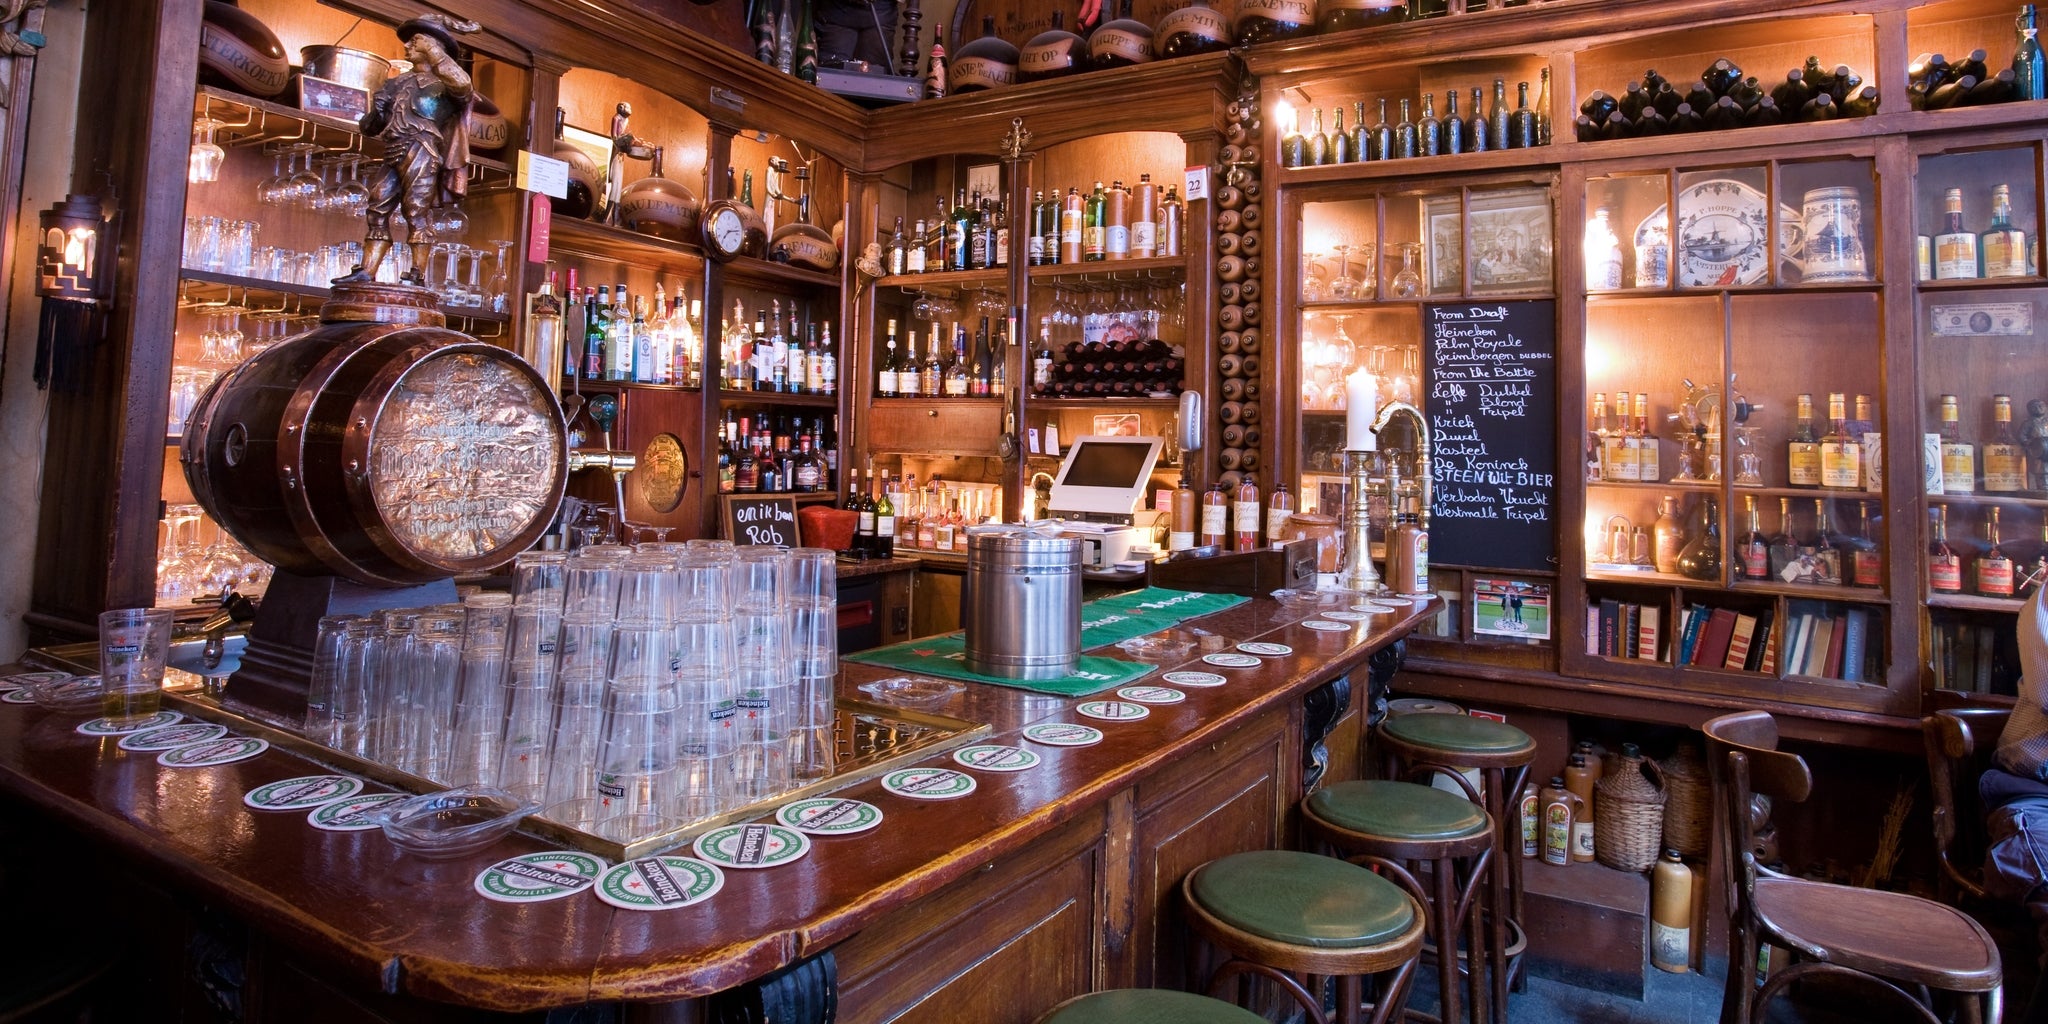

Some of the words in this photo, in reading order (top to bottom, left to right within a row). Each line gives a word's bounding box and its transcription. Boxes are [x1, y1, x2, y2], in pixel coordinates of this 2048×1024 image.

[1041, 51, 1058, 62] OP
[1187, 179, 1201, 191] 22
[1708, 205, 1737, 213] HOPPE
[1433, 307, 1464, 320] From
[1470, 306, 1509, 320] Draft
[1435, 338, 1469, 350] Palm
[1473, 334, 1523, 352] Royale
[1433, 367, 1467, 380] From
[1470, 367, 1491, 378] the
[1432, 382, 1468, 402] Leffe
[1479, 383, 1533, 397] Dubbel
[1480, 397, 1528, 408] Blond
[1478, 407, 1525, 420] Tripel
[1434, 415, 1474, 428] Kriek
[1433, 429, 1481, 441] Duvel
[1434, 442, 1488, 455] Kasteel
[1434, 457, 1456, 469] De
[1465, 455, 1528, 470] Koninck
[1434, 469, 1485, 483] STEEN
[1488, 471, 1513, 485] Wit
[1516, 471, 1553, 487] BIER
[1432, 484, 1495, 503] Verboden
[1499, 487, 1549, 505] Vrucht
[760, 503, 772, 519] ik
[1433, 502, 1498, 518] Westmalle
[1502, 506, 1547, 524] Tripel
[746, 524, 783, 545] Rob
[902, 772, 956, 792] Heineken
[803, 803, 856, 828] Heineken
[740, 827, 764, 862] Heineken
[501, 862, 580, 886] Heineken
[672, 861, 705, 873] QUALITY
[643, 861, 682, 902] Heineken
